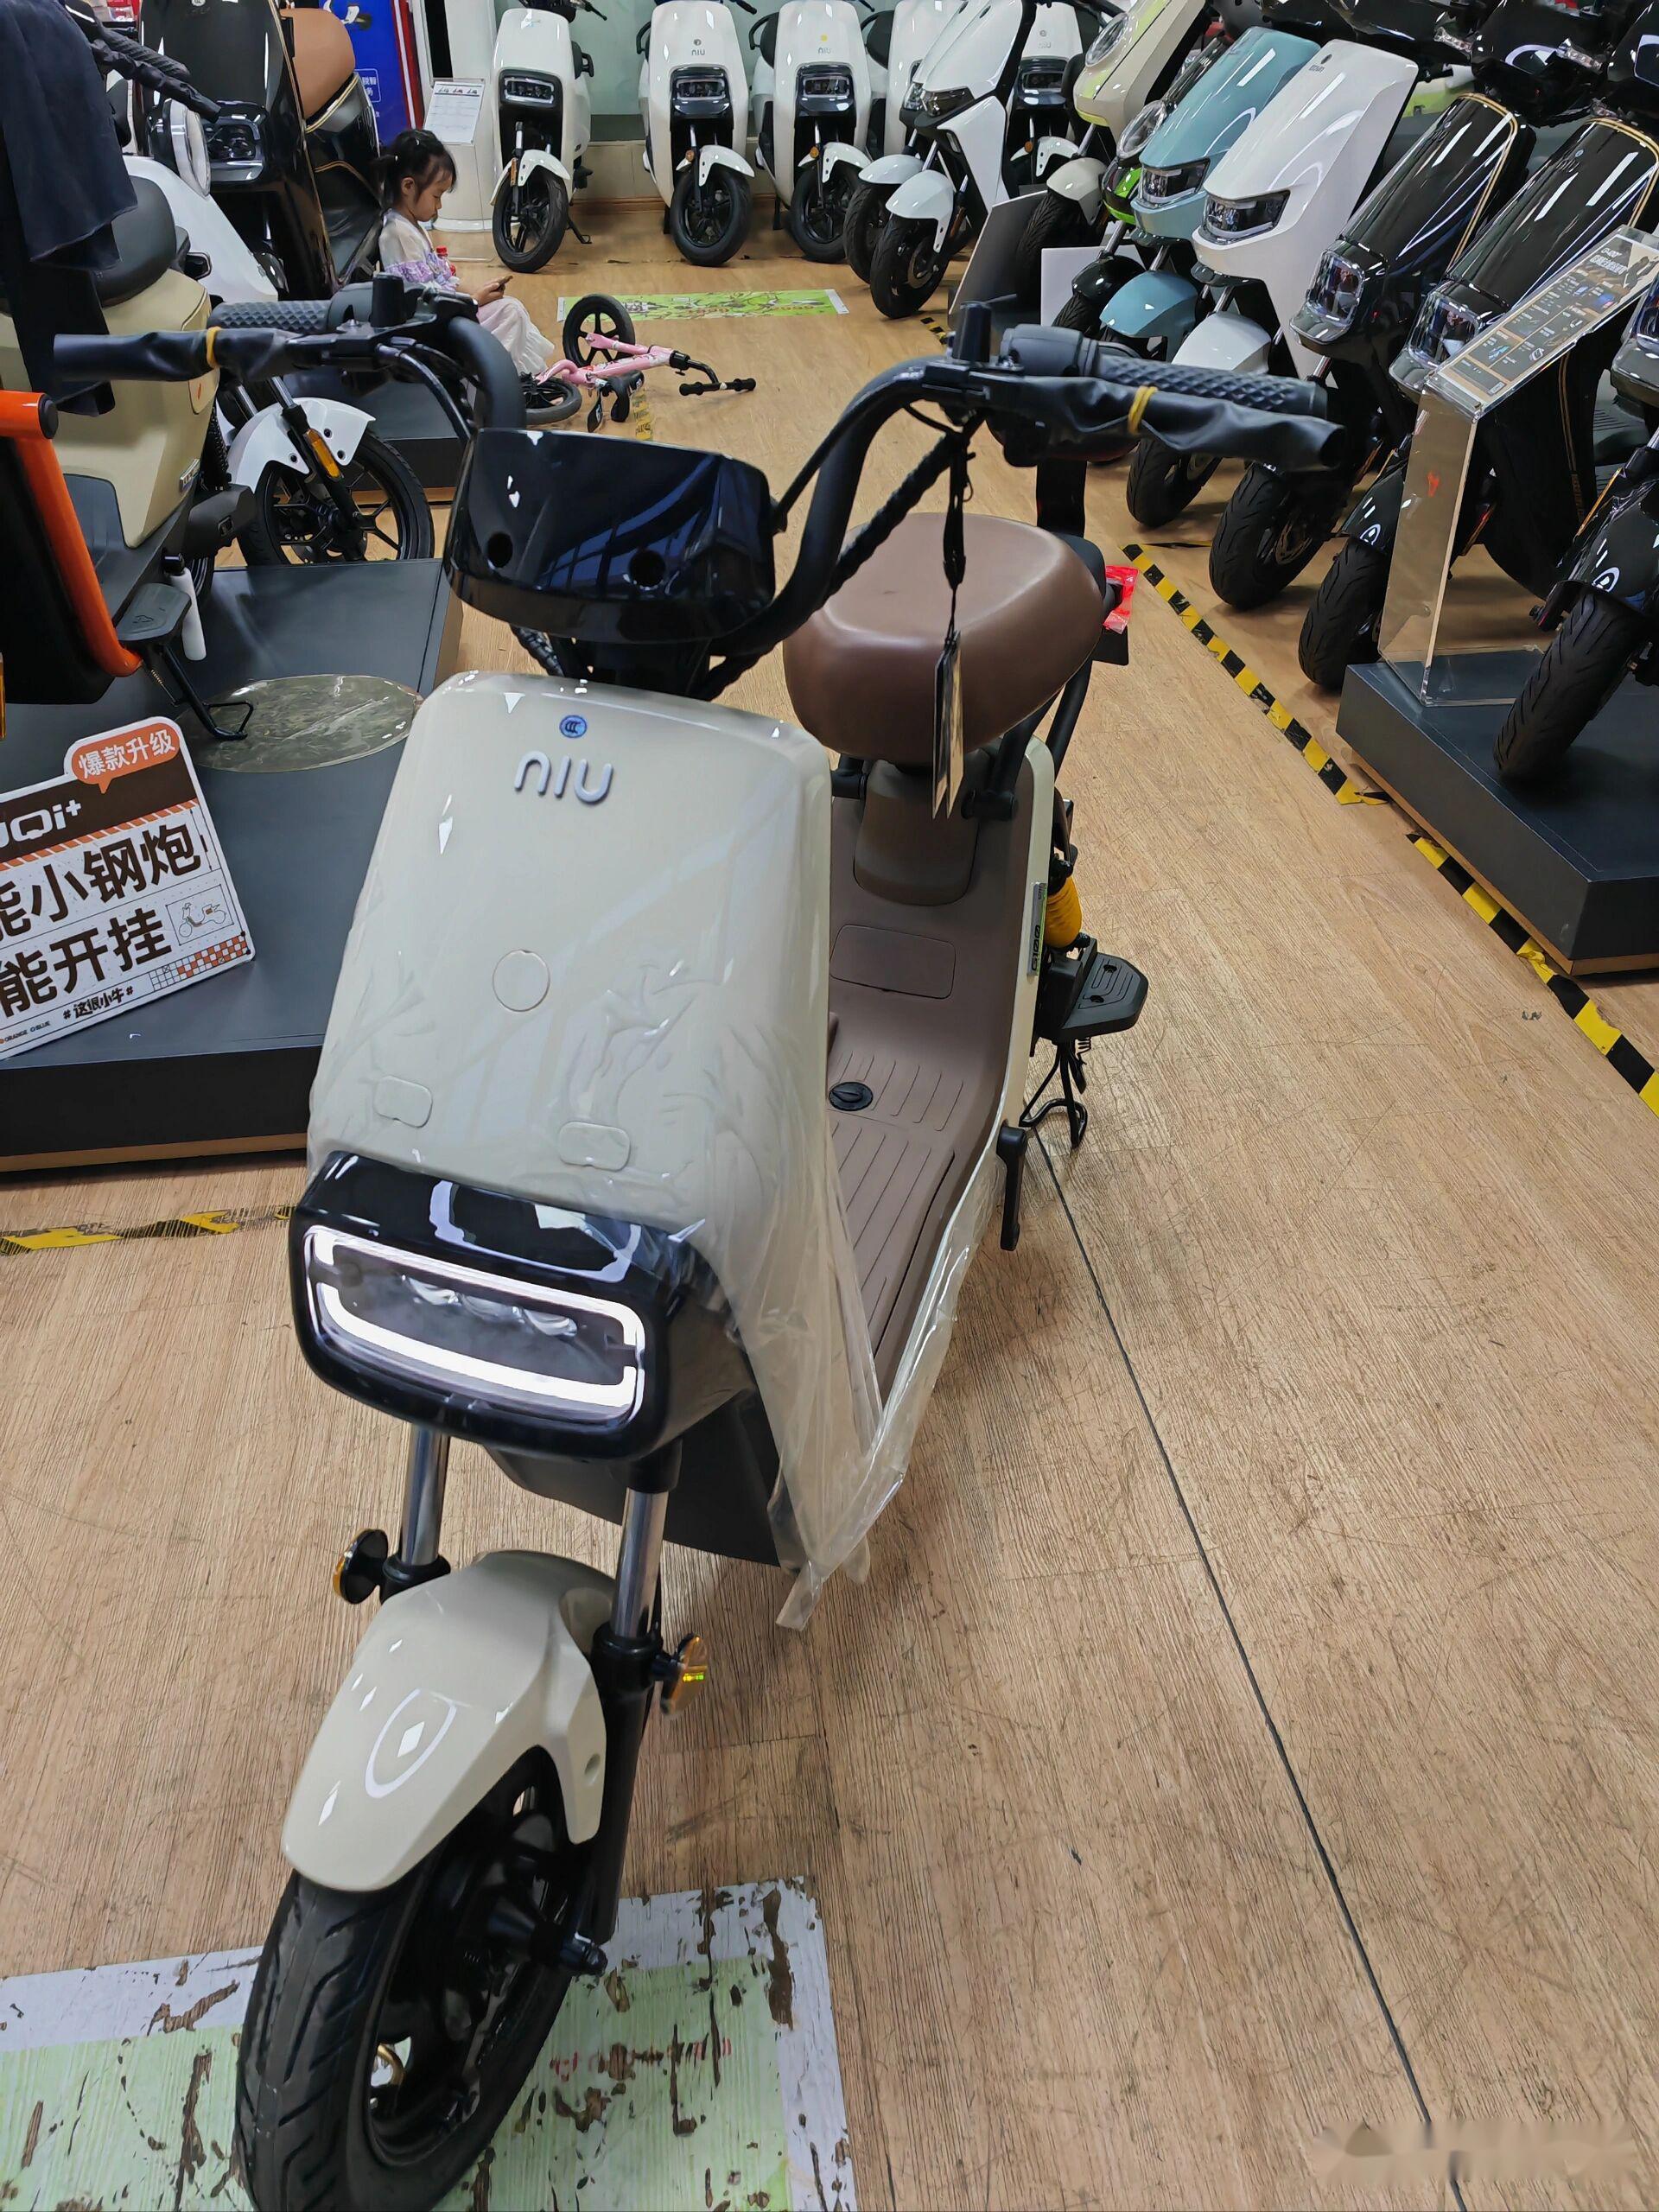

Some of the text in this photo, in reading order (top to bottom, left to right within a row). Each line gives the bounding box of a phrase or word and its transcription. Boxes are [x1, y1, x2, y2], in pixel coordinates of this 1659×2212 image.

[79, 729, 175, 779] 爆款升级
[0, 907, 172, 1018] 能开挂
